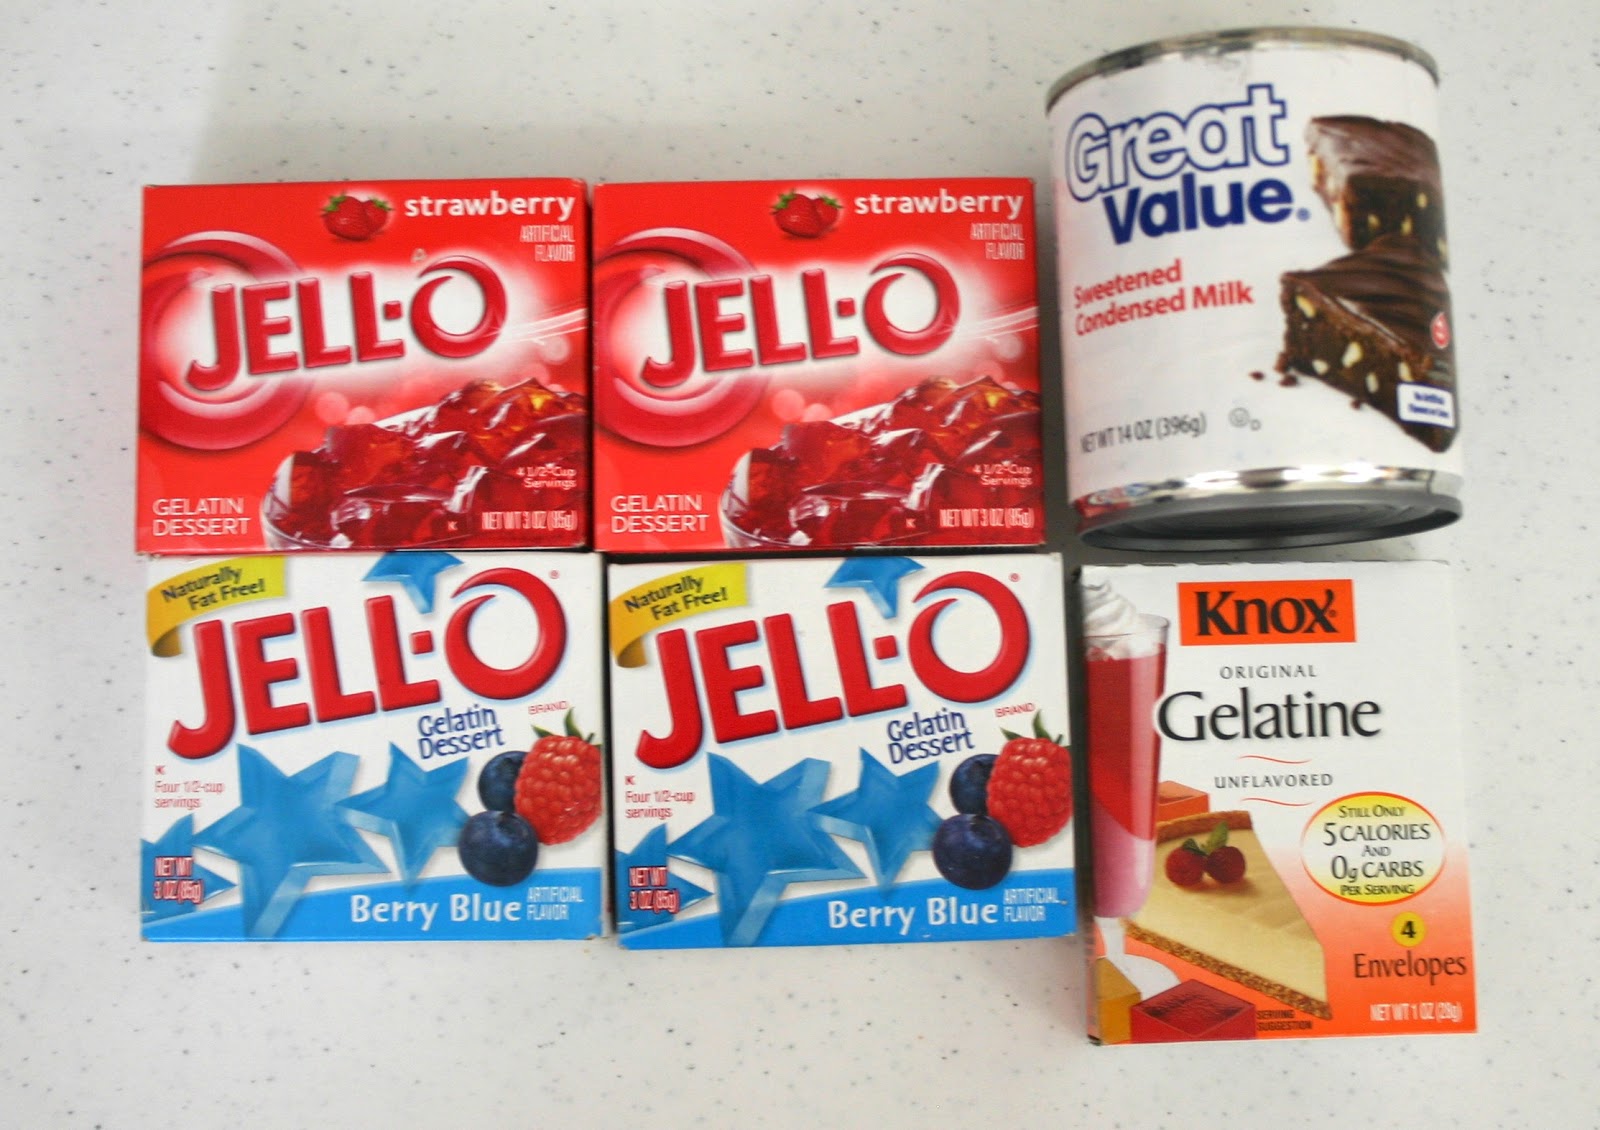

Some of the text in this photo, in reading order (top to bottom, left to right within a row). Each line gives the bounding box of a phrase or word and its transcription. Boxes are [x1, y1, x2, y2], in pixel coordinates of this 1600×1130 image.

[1065, 83, 1290, 203] Great
[404, 190, 576, 222] strawberry
[854, 188, 1024, 220] strawberry
[1103, 172, 1294, 245] Value
[519, 225, 576, 243] ARTIFICIAL
[970, 223, 1025, 240] ARTIFICIAL
[534, 244, 576, 262] FLAVOR
[985, 242, 1026, 260] FLAVOR
[1074, 258, 1183, 309] Sweetened
[1075, 280, 1254, 336] Condensed Milk
[1118, 424, 1132, 444] 14
[1133, 419, 1153, 441] OZ
[1156, 402, 1208, 440] (396g)
[973, 463, 982, 475] 4
[523, 477, 577, 490] Servings
[980, 474, 1033, 488] Servings
[152, 498, 244, 516] GELATIN
[610, 494, 702, 513] GELATIN
[152, 517, 252, 536] DESSERT
[482, 510, 578, 531] NET WT 3 OZ (85g)
[611, 514, 710, 533] DESSERT
[940, 507, 1035, 529] NET WT 3 OZ (85g)
[162, 566, 242, 602] Naturally
[188, 578, 266, 610] Fat Free!
[624, 575, 704, 613] Naturally
[651, 587, 728, 620] Fat Free!
[1195, 589, 1338, 636] Knox
[1220, 664, 1317, 679] ORIGINAL
[528, 701, 569, 715] BRAND
[995, 702, 1036, 718] BRAND
[1158, 686, 1381, 741] Gelatine
[417, 703, 496, 737] Gelatin
[887, 707, 966, 742] Gelatin
[418, 725, 505, 760] Dessert
[888, 727, 975, 764] Dessert
[154, 781, 180, 793] Four
[1214, 773, 1333, 789] UNFLAVORED
[154, 797, 201, 811] servings
[625, 791, 651, 803] Four
[625, 807, 673, 820] servings
[1338, 806, 1371, 818] STILL
[1322, 822, 1431, 846] 5 CALORIES
[1361, 845, 1391, 857] AND
[154, 856, 194, 877] NET WT
[1331, 855, 1424, 883] 0g CARBS
[629, 866, 668, 887] NET WT
[154, 879, 204, 904] 3 OZ (85g)
[527, 886, 584, 903] ARTIFICIAL
[1004, 888, 1060, 904] ARTIFICIAL
[1340, 884, 1415, 895] PER SERVING
[629, 888, 680, 914] 3 OZ (85g)
[351, 893, 521, 931] Berry Blue
[527, 904, 569, 920] FLAVOR
[828, 897, 998, 935] Berry Blue
[1004, 906, 1046, 922] FLAVOR
[1402, 921, 1416, 938] 4
[1354, 951, 1467, 985] Envelopes
[1257, 1010, 1294, 1019] SERVING
[1370, 1002, 1462, 1022] NET WT 1 OZ (28g)
[1258, 1021, 1312, 1031] SUGGESTION
